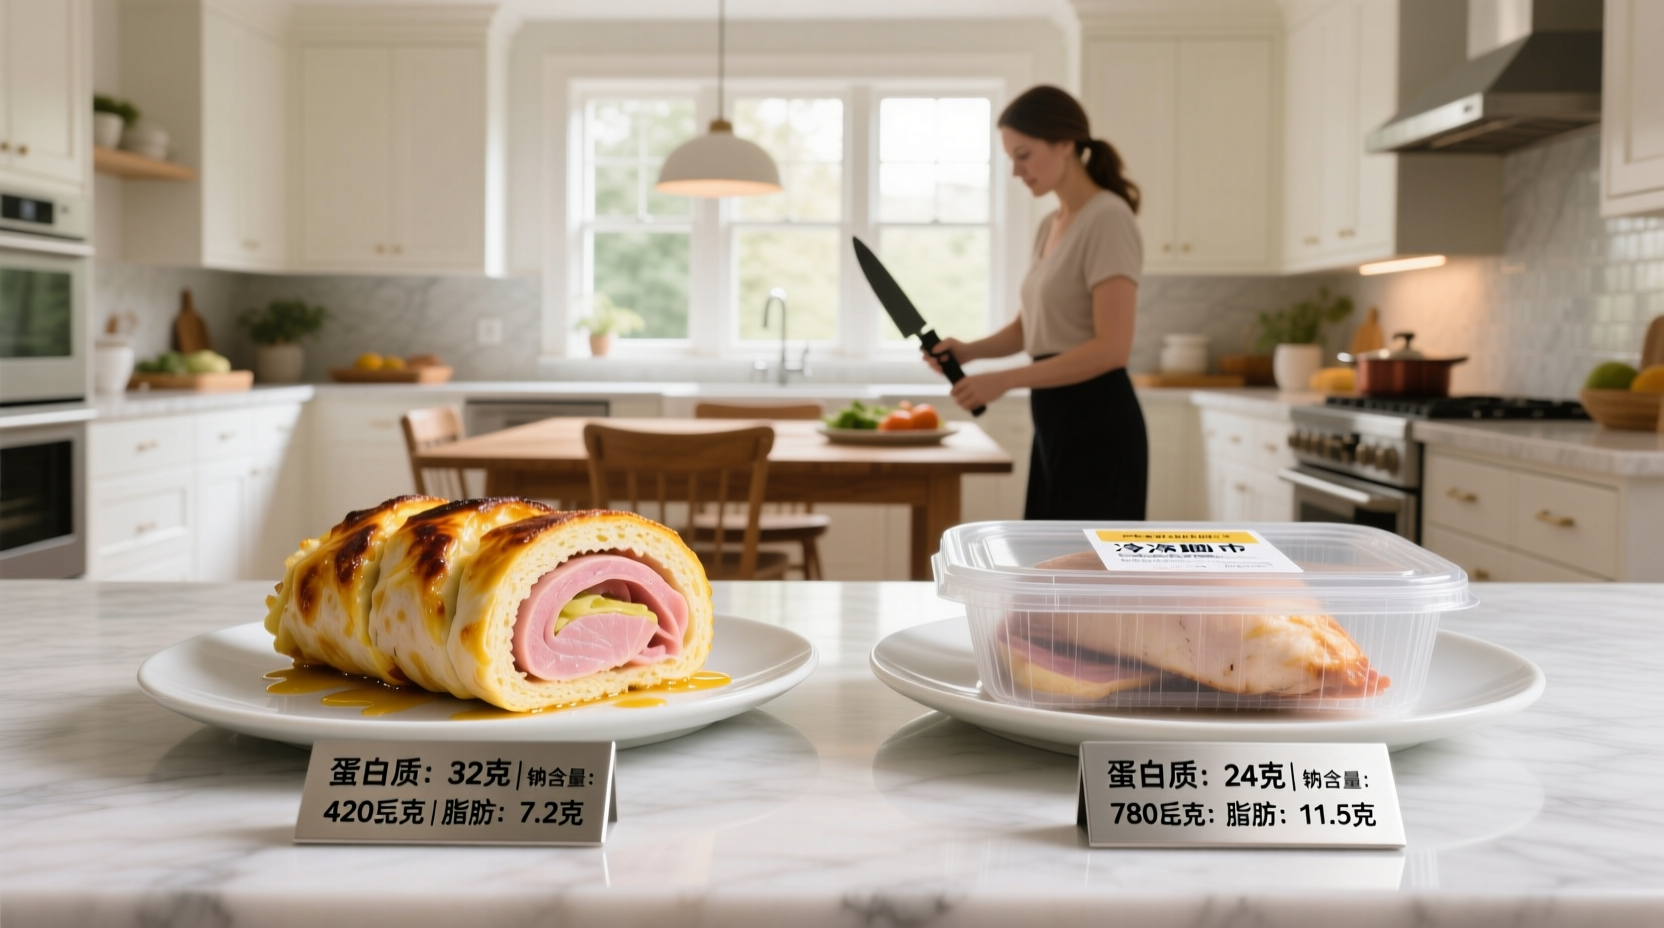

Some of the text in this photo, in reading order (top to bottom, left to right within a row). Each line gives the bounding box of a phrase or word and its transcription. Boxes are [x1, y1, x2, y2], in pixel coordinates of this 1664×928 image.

[328, 757, 432, 787] 蛋白质：
[1107, 759, 1208, 790] 蛋白质：
[520, 799, 585, 826] 7.2克
[1299, 802, 1377, 827] 11.5克
